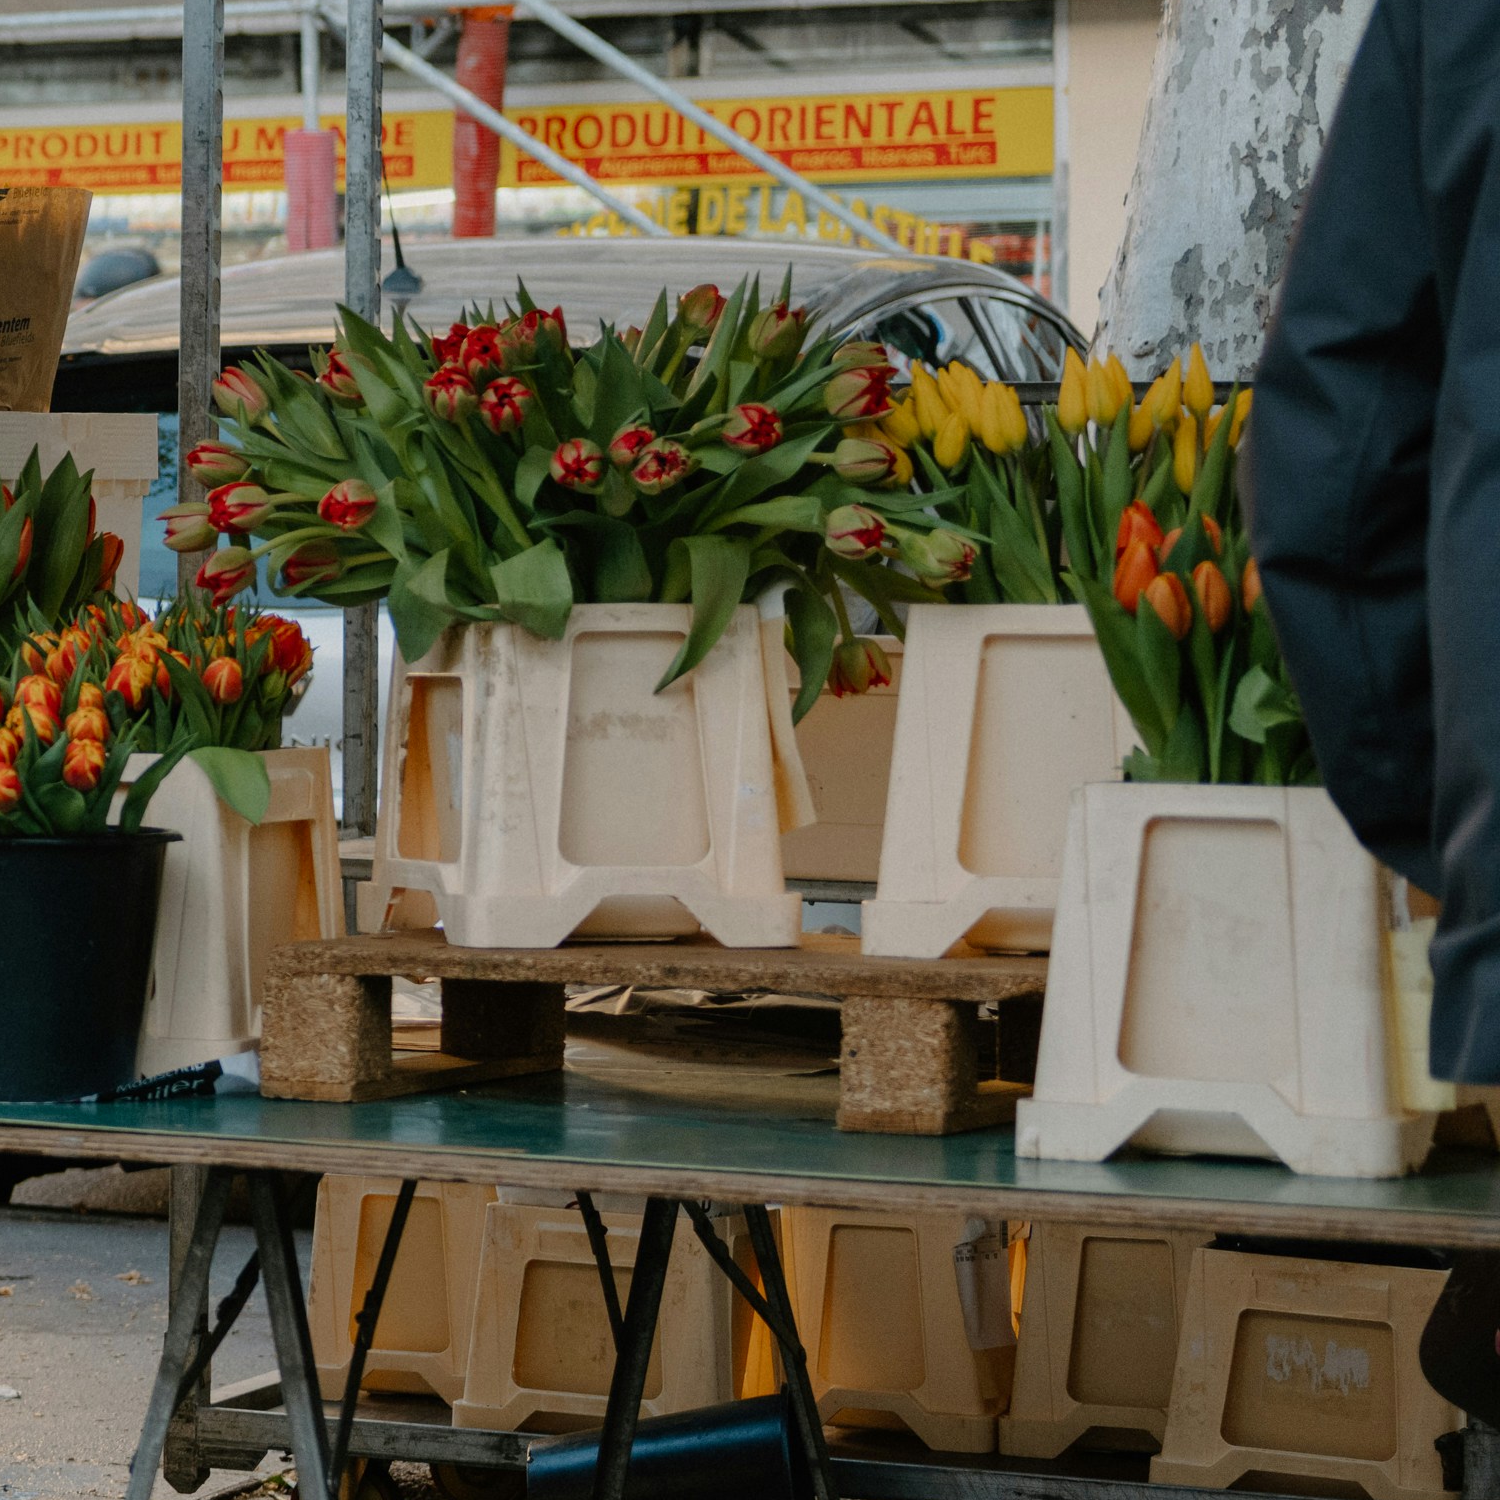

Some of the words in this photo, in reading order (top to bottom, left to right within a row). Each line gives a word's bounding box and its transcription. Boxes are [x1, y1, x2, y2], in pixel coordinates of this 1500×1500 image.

[518, 109, 708, 153] PRODUIT
[729, 97, 997, 144] ORIENTALE
[703, 186, 749, 235] DE
[760, 185, 808, 235] LA
